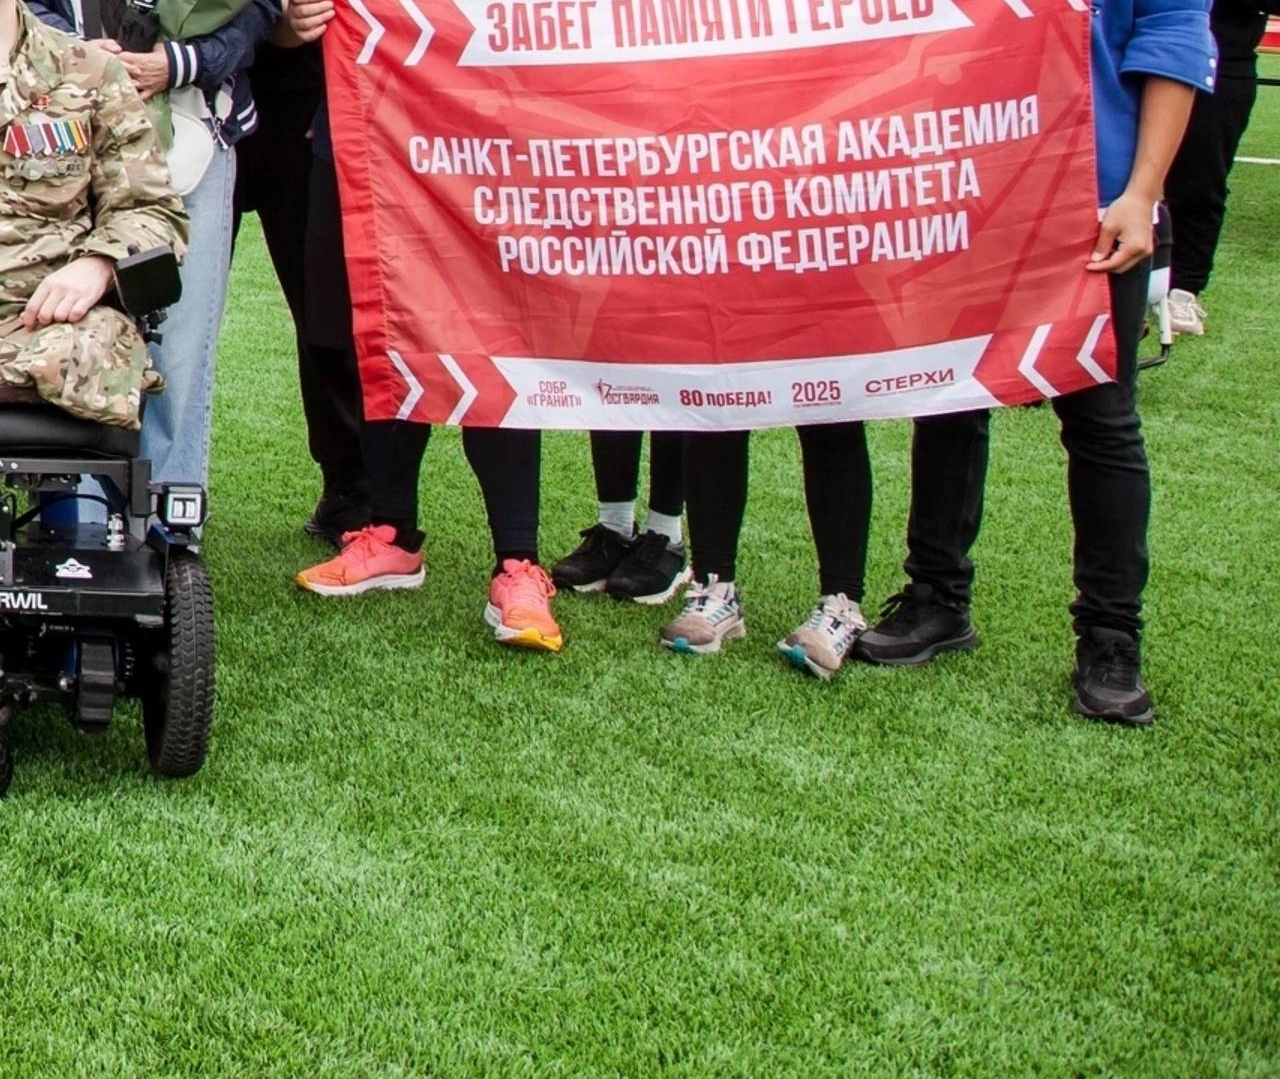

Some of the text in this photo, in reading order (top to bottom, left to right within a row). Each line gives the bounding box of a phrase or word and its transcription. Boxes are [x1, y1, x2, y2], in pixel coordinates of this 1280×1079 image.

[486, 1, 597, 53] ЗАБЕГ
[408, 94, 1040, 177] САНКТ-ПЕТЕРБУРГСКАЯ АКАДЕМИЯ
[472, 159, 981, 229] СЛЕДСТВЕННОГО КОМИТЕТА
[498, 211, 970, 277] РОССИЙСКОЙ ФЕДЕРАЦИИ
[539, 381, 567, 394] СОБР
[792, 380, 841, 403] 2025
[865, 368, 954, 393] СТЕРХИ
[527, 393, 582, 408] «ГРАНИТ»
[679, 389, 703, 407] 80
